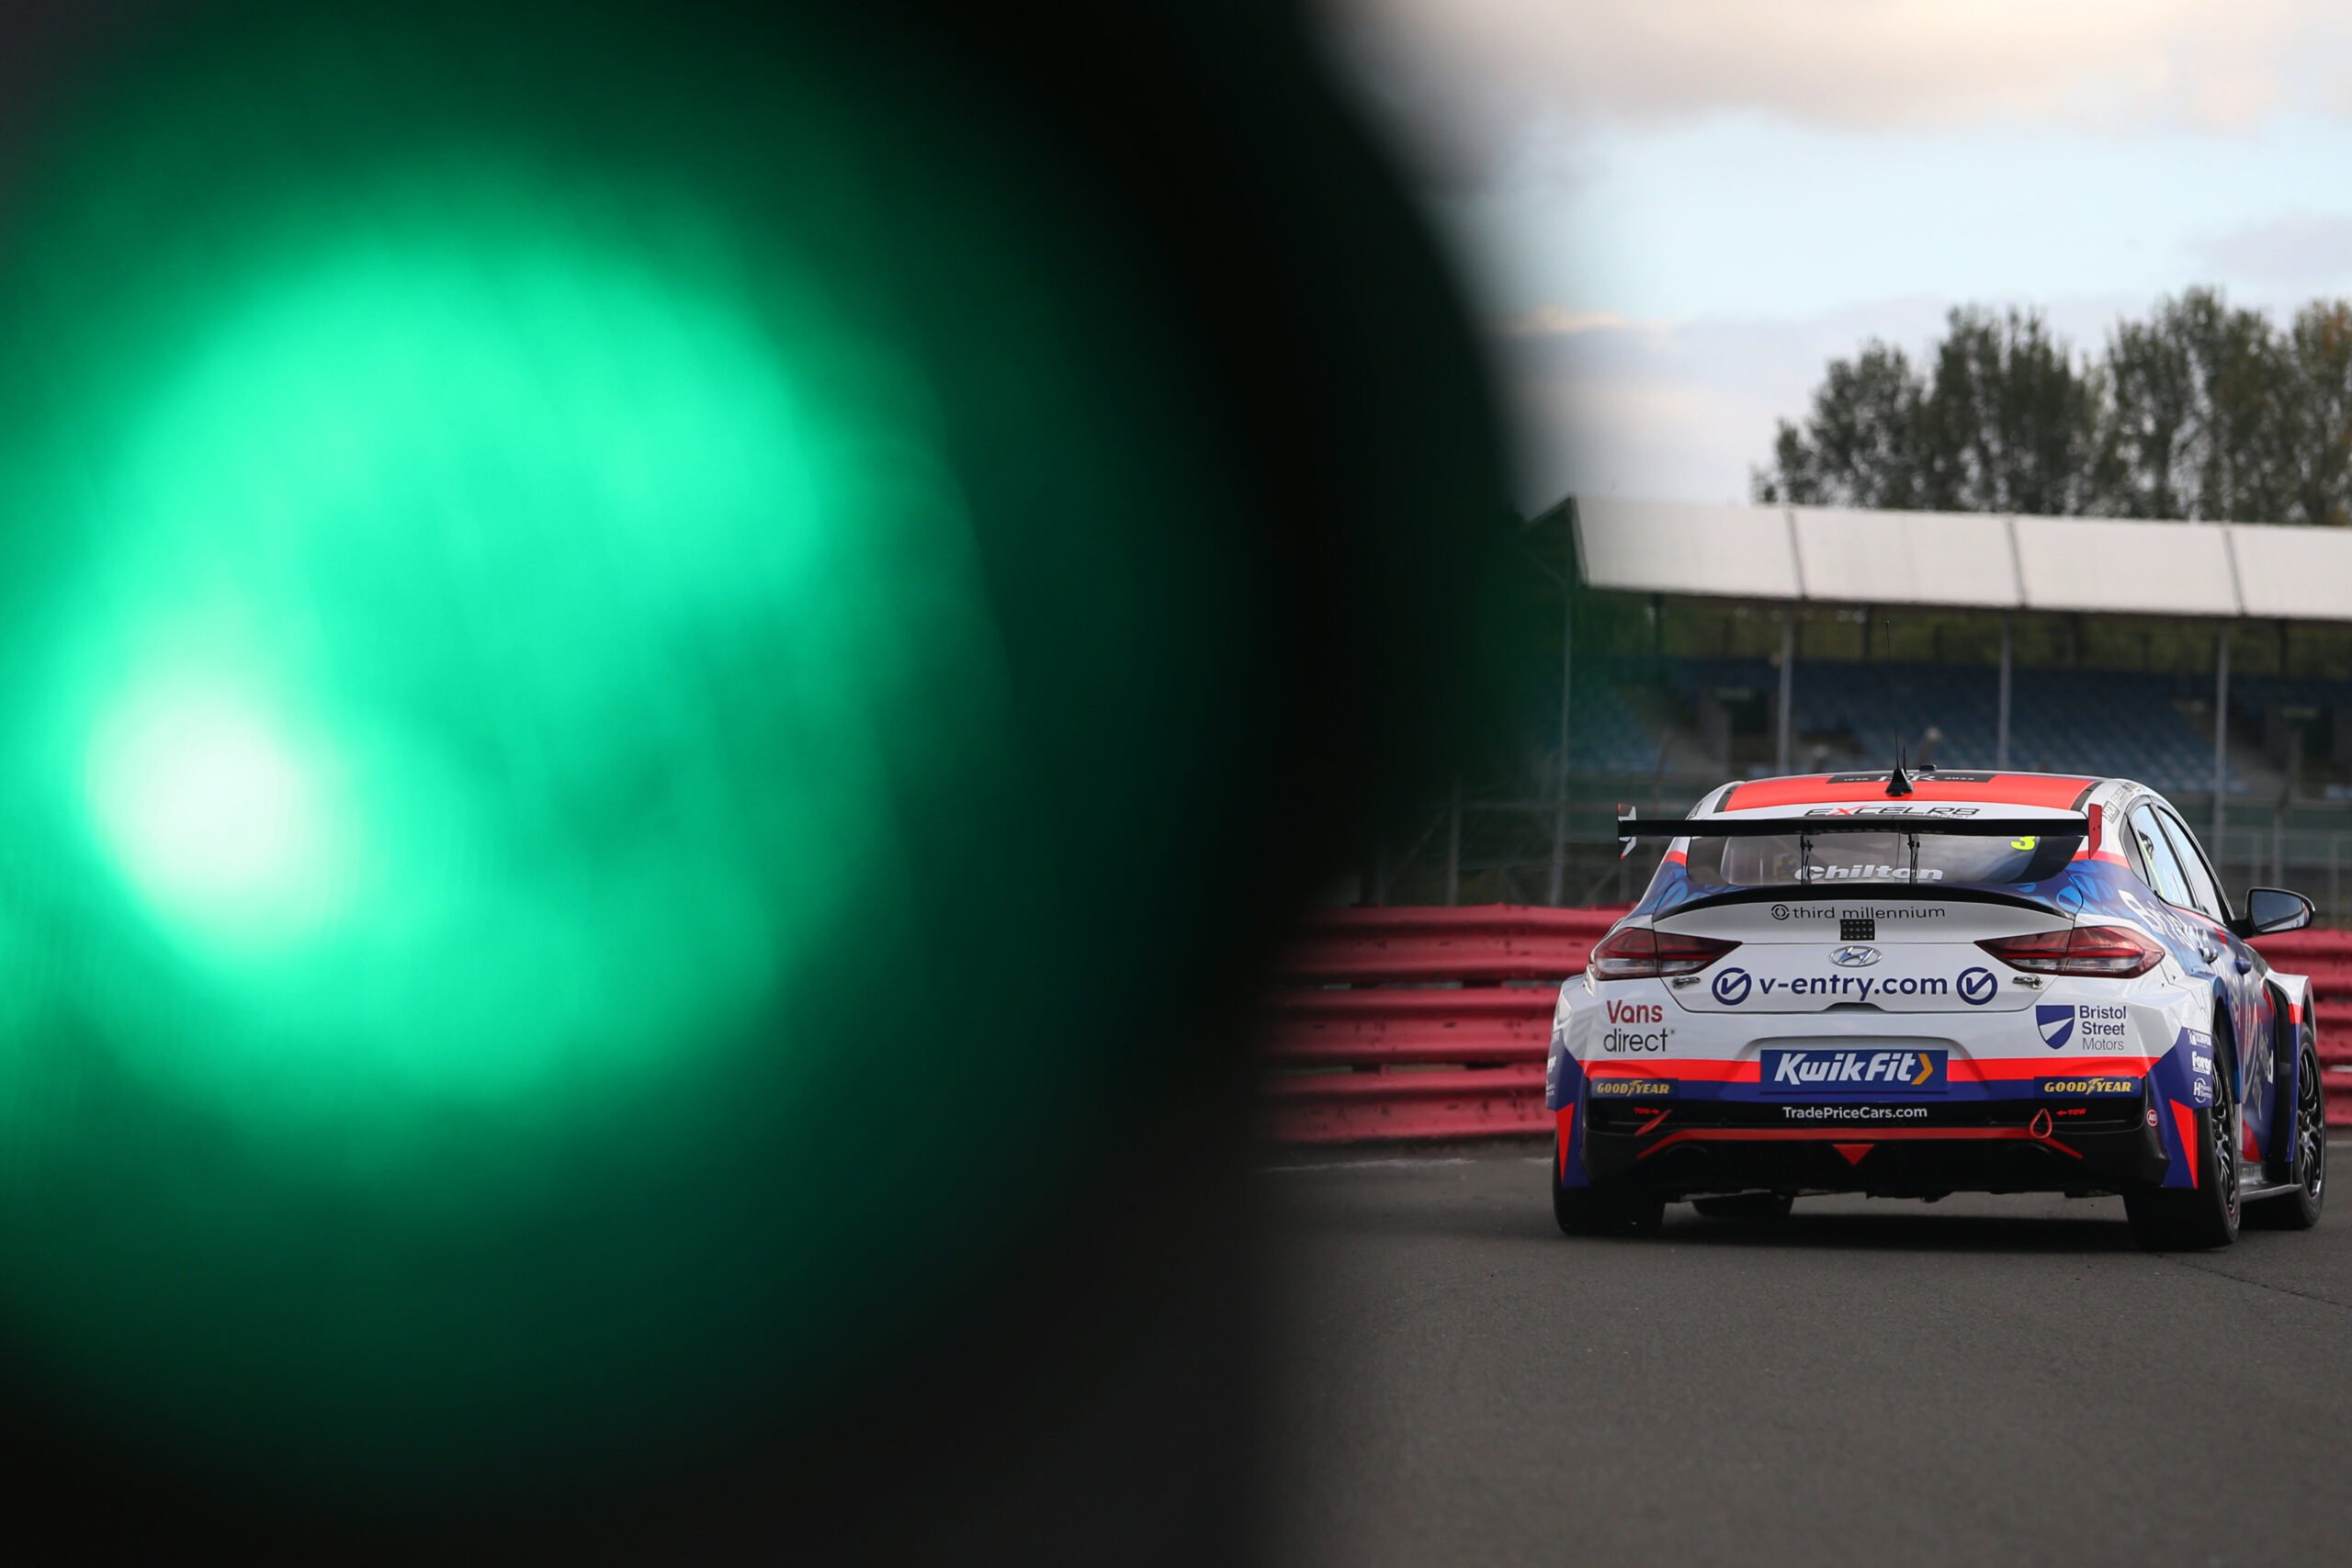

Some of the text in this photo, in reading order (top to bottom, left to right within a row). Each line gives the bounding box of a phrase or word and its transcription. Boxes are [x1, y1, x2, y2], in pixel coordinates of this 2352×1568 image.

[2010, 836, 2036, 851] 3
[1793, 864, 1944, 881] Chilton
[1792, 906, 1946, 919] third millennium
[1759, 974, 1948, 1001] v-entry.com
[1606, 999, 1663, 1024] Vans
[2079, 1005, 2127, 1020] Bristol
[2081, 1021, 2125, 1035] Street
[1603, 1028, 1668, 1053] direct
[2082, 1037, 2124, 1051] Motors
[1597, 1080, 1670, 1096] GOODYEAR
[2043, 1078, 2132, 1095] GOODYEAR
[1782, 1106, 1928, 1119] TradePriceCars.com
[2067, 1108, 2087, 1116] TOW
